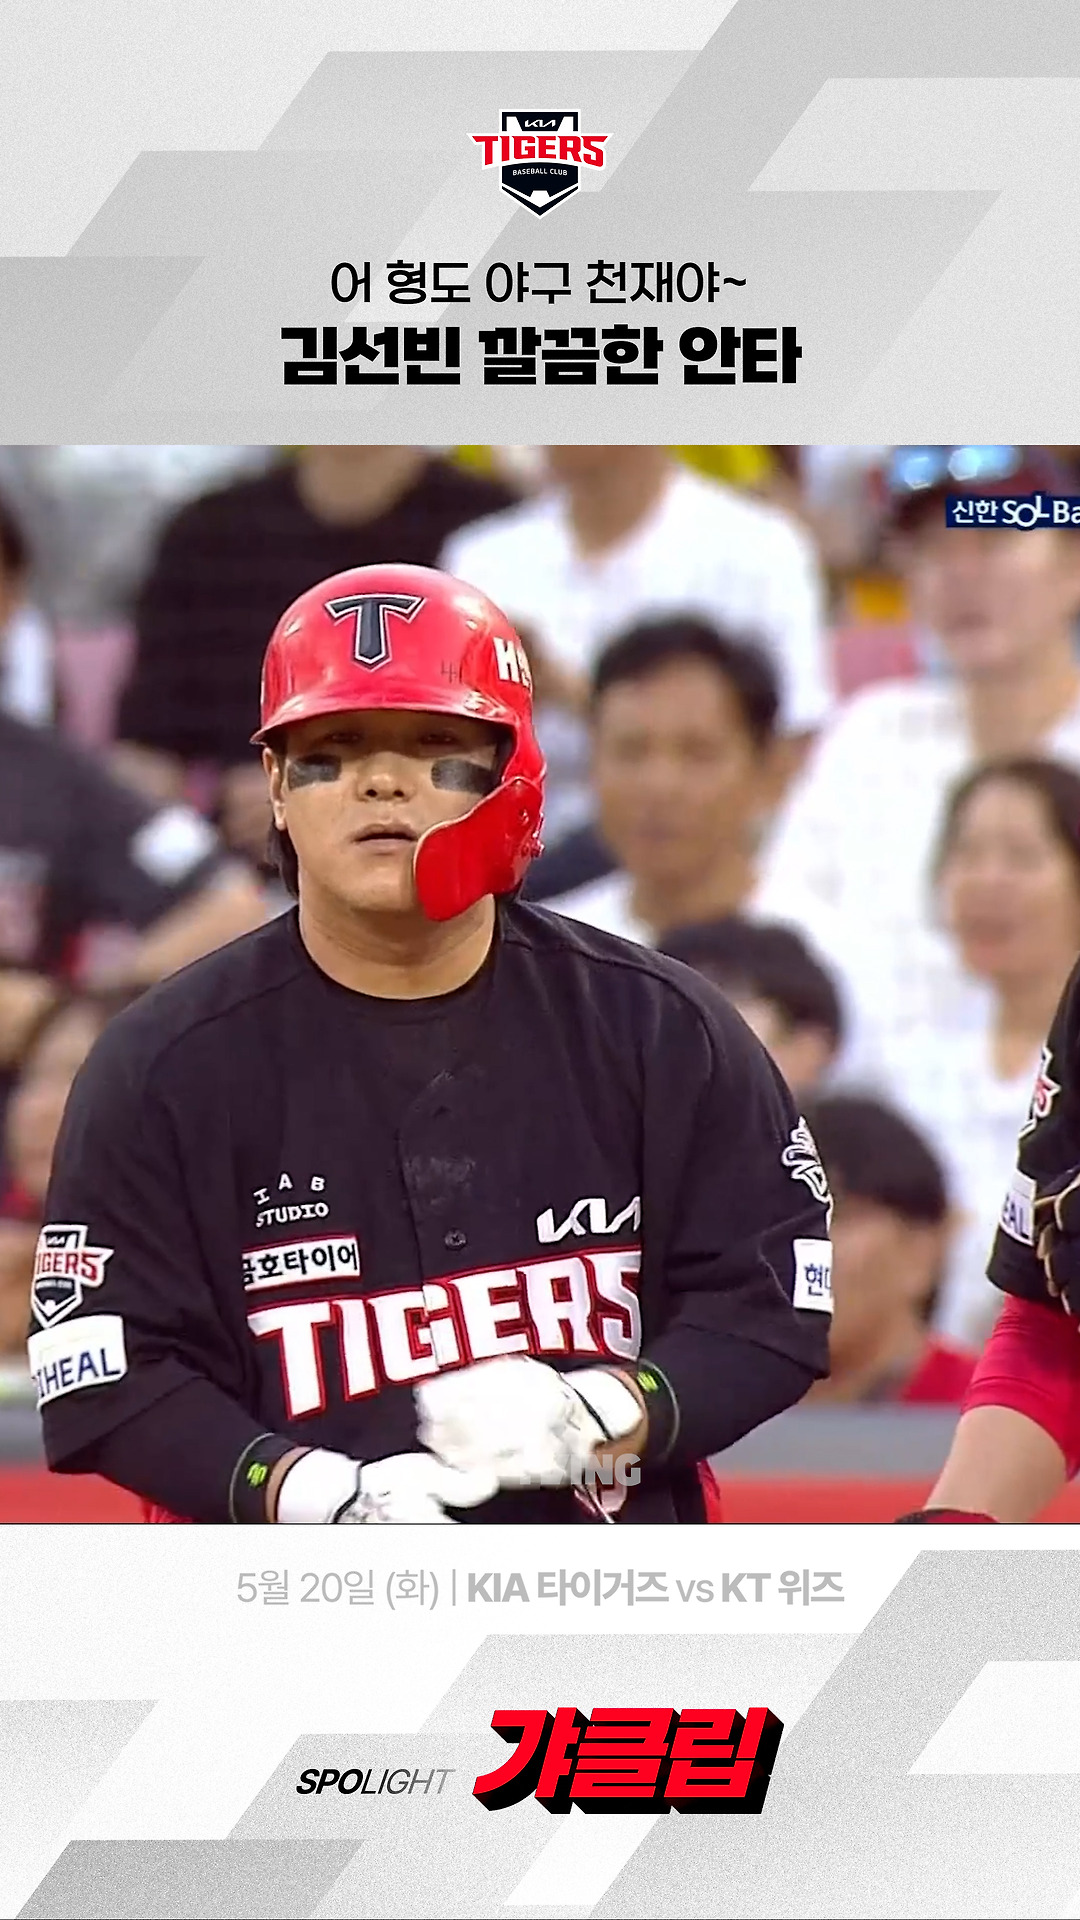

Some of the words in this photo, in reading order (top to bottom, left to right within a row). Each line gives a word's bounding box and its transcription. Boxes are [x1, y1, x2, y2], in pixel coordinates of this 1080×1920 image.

[324, 593, 427, 672] T
[256, 1202, 330, 1228] STUDIO
[246, 1250, 642, 1420] TIGERS
